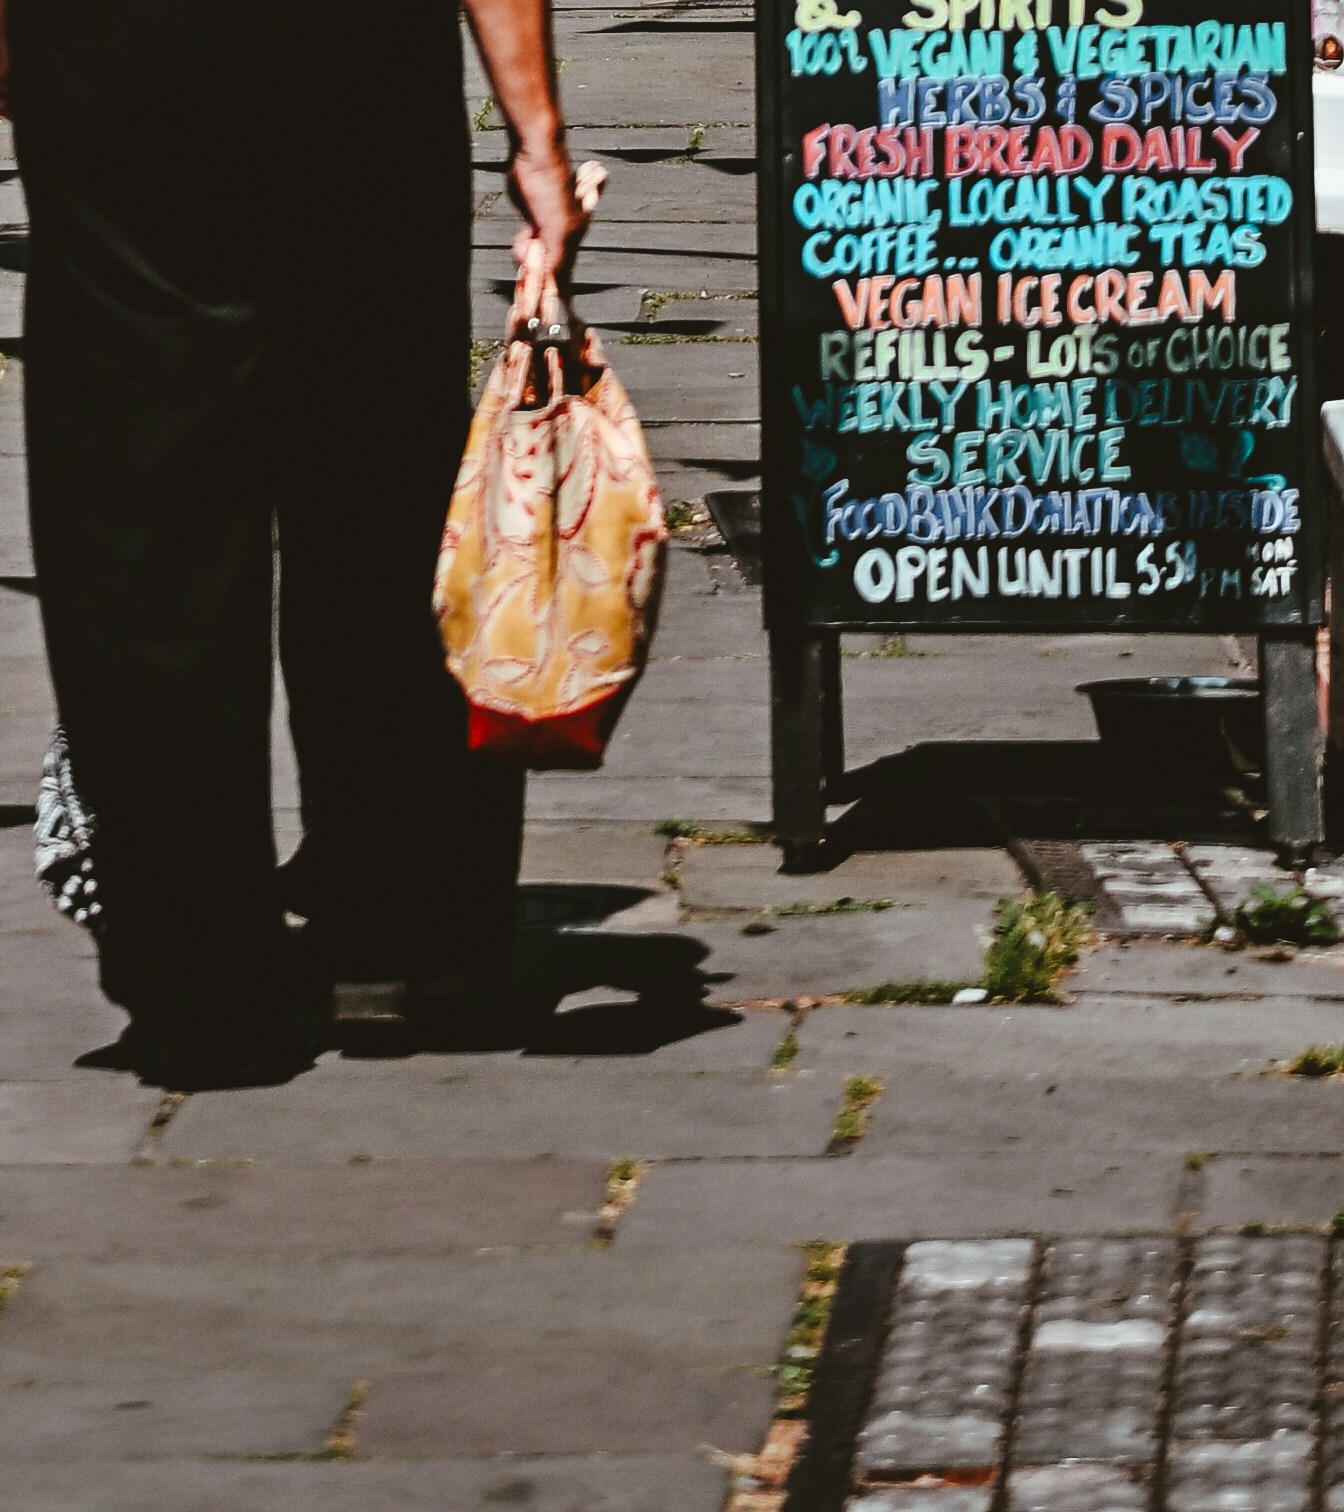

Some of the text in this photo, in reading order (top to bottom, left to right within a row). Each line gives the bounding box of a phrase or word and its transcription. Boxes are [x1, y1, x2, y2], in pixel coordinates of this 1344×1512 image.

[868, 28, 1004, 78] VEGAN
[1047, 20, 1286, 81] VEGETARIAN
[878, 73, 1047, 128] HERBS
[1089, 70, 1277, 127] SPICES
[801, 124, 1262, 180] FRESH BREAD DAILY
[793, 174, 1293, 231] ORGANIC LOCALLY ROASTED
[989, 222, 1140, 272] ORGANIC
[1149, 222, 1267, 268] TEAS
[832, 269, 1237, 331] VEGAN ICE CREAM
[819, 327, 989, 382] REFILLS
[1027, 323, 1119, 377] LOTS
[1166, 322, 1292, 373] CHOICE
[790, 374, 1299, 435] WEEKLY HOME DELIVERY
[905, 426, 1132, 486] SERVICE
[1186, 487, 1302, 537] INSIDE
[853, 546, 990, 604] OPEN
[997, 547, 1133, 600] UNTIL
